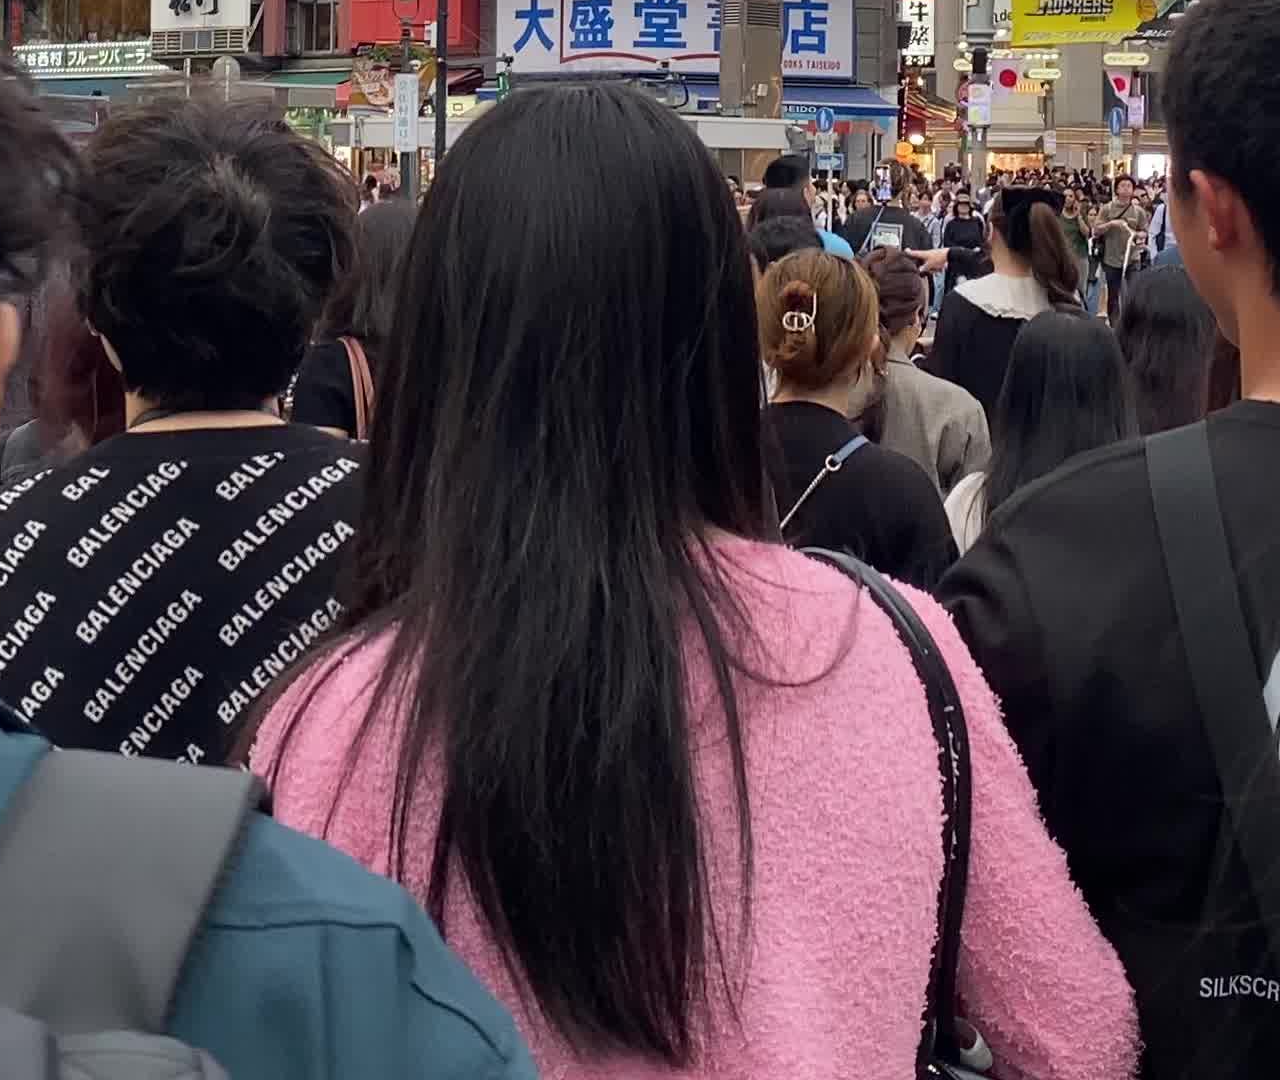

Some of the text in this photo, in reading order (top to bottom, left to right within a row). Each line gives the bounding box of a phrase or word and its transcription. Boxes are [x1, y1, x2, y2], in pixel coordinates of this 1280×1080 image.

[806, 59, 841, 71] TAISEIDO
[66, 459, 188, 568] BALENCIAG
[218, 457, 360, 572] BALENCIAGA
[75, 517, 201, 645] BALENCIAGA
[218, 520, 356, 647] BALENCIAGA
[83, 589, 204, 723] BALENCIAGA
[217, 597, 345, 725] BALENCIAGA
